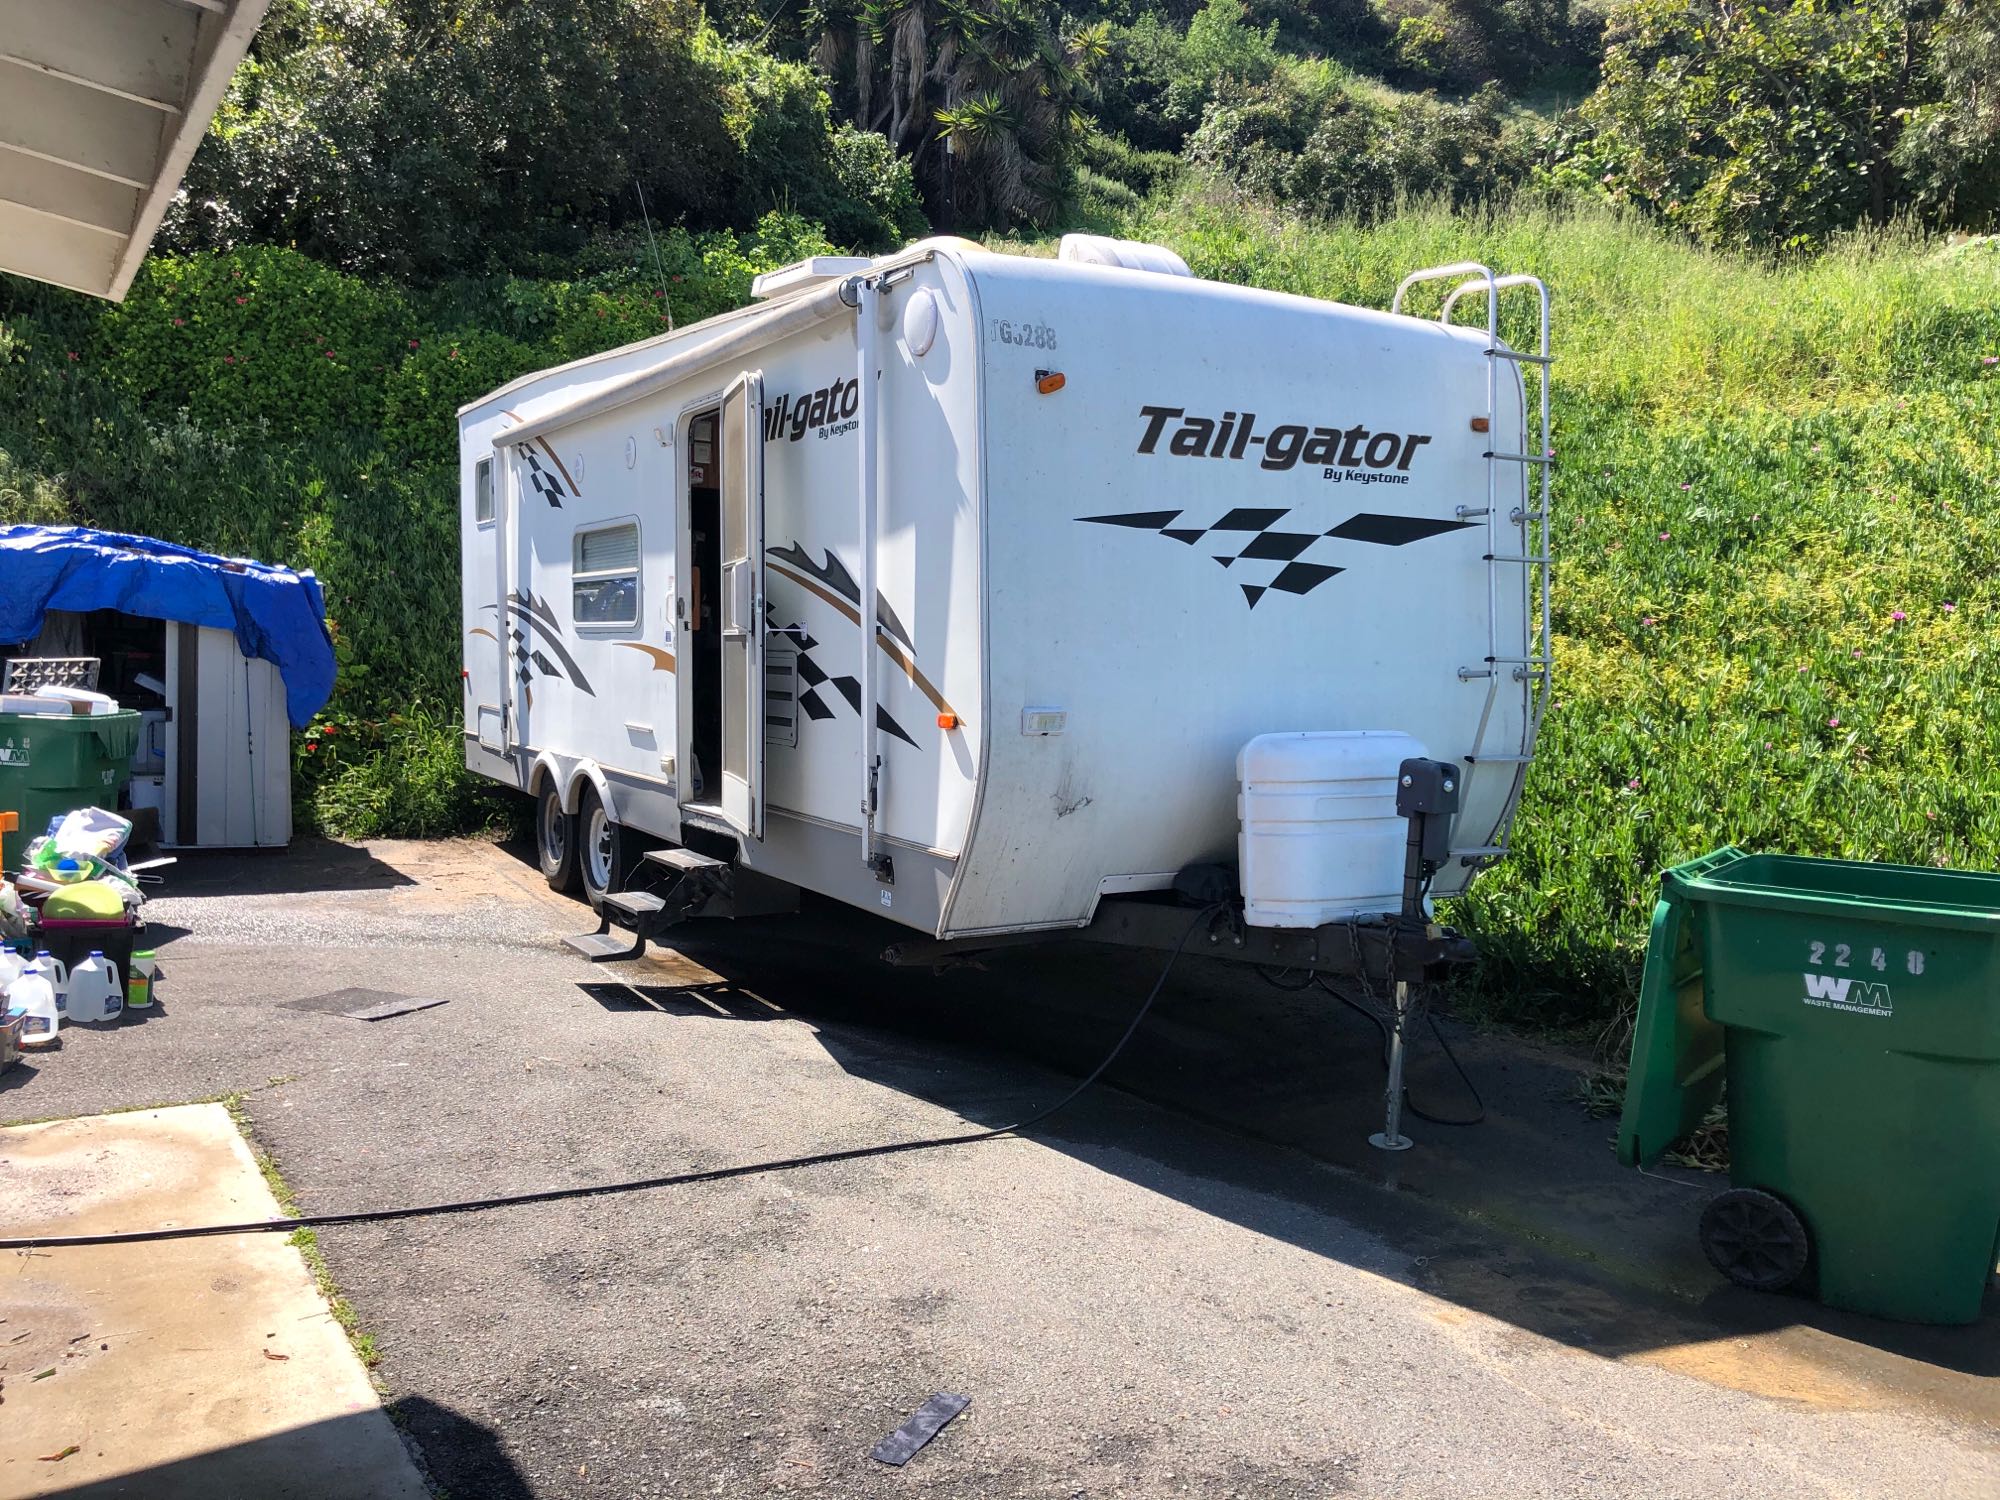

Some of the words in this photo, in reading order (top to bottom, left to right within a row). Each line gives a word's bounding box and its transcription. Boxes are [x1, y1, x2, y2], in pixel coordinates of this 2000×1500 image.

[818, 427, 829, 440] By
[830, 420, 859, 437] Keysto
[1137, 405, 1432, 471] Tail-gator
[1323, 468, 1343, 483] By
[1345, 469, 1410, 485] Keystone
[1803, 973, 1893, 1009] WM
[1803, 997, 1832, 1009] WASTE
[1833, 1002, 1893, 1017] MANAGEMENT
